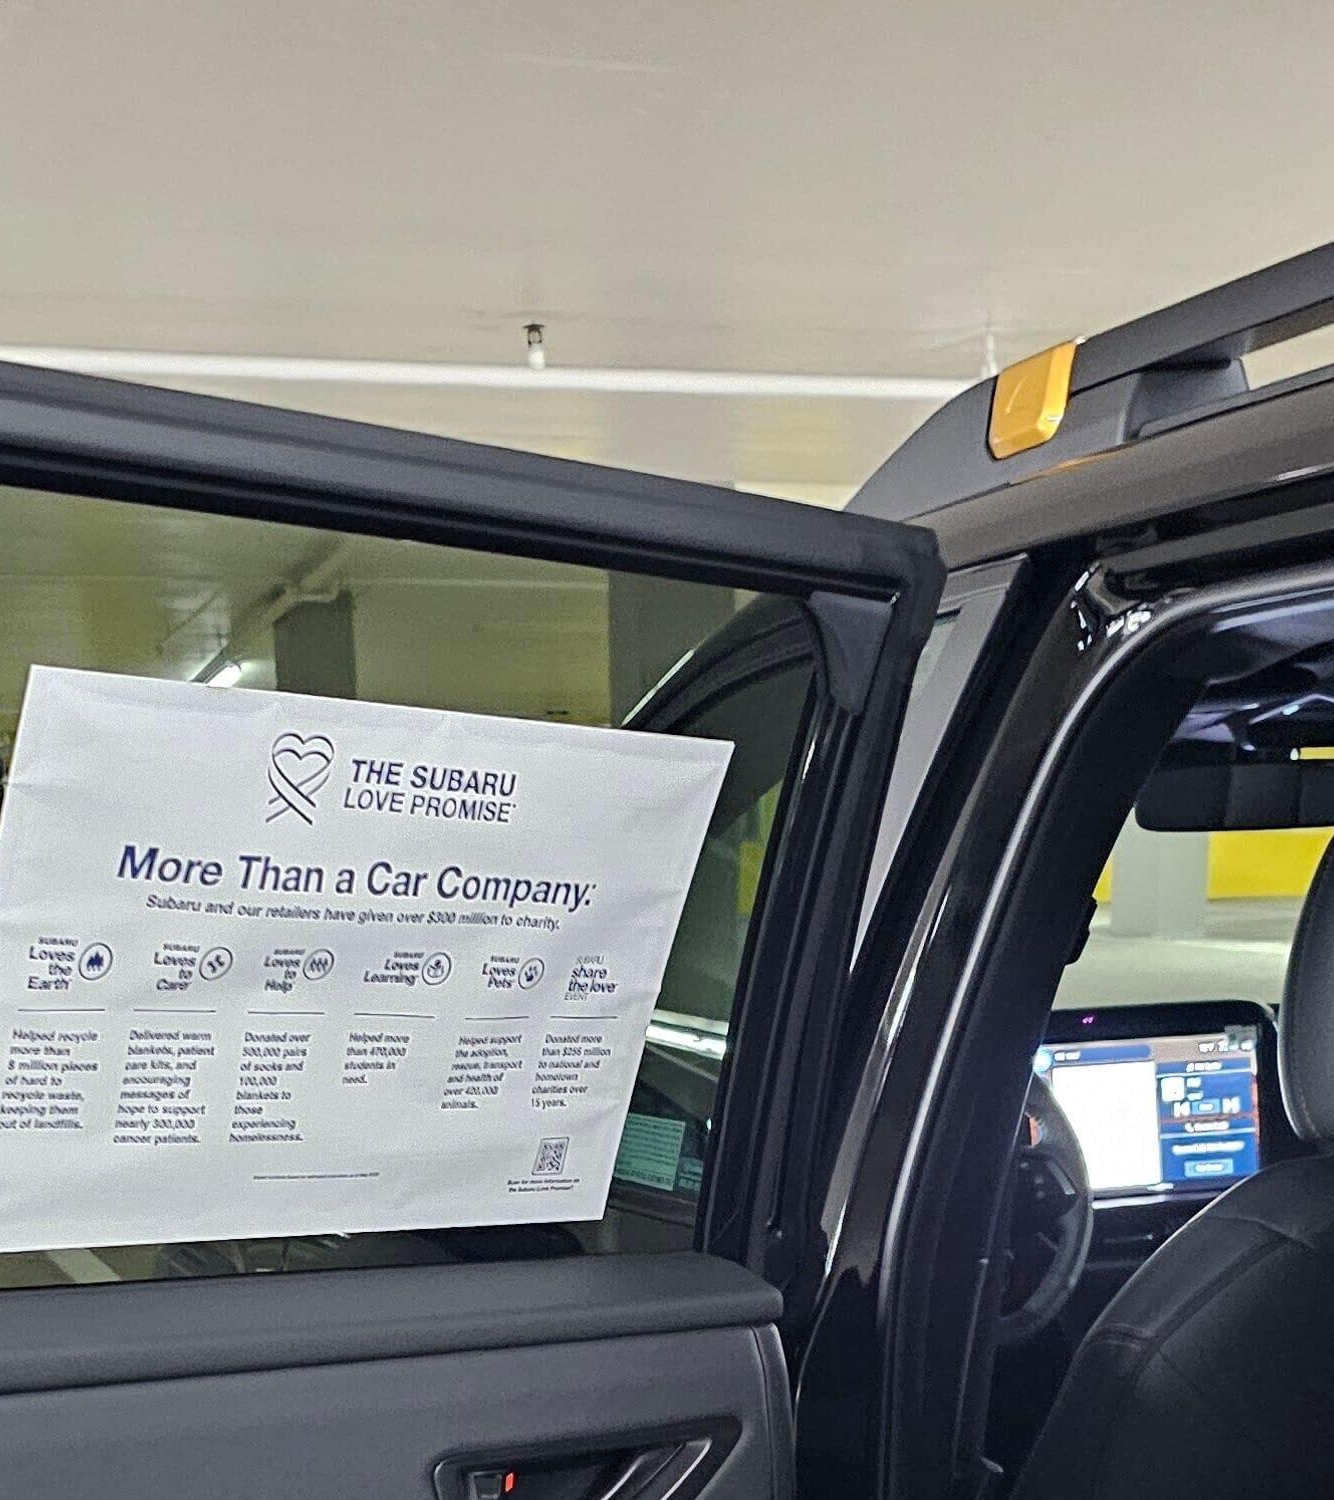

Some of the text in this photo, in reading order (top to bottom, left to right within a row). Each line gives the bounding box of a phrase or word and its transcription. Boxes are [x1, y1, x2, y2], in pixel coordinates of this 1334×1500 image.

[350, 758, 516, 797] THE SUBARU
[344, 787, 511, 824] LOVE PROMISE
[117, 845, 223, 886] More
[239, 854, 323, 893] Than
[335, 869, 355, 894] a
[368, 861, 428, 897] Car
[146, 894, 560, 932] Subaru and our retailers have given over $300 million to charity.
[29, 947, 75, 961] Loves
[154, 952, 196, 967] Loves
[264, 957, 300, 968] Loves
[384, 959, 420, 970] Loves
[49, 963, 72, 976] the
[179, 968, 192, 980] to
[284, 969, 297, 980] to
[482, 963, 516, 977] Loves
[571, 965, 607, 979] share
[27, 976, 70, 990] Earth
[364, 971, 415, 986] Learning
[488, 977, 512, 988] Pets
[265, 980, 293, 994] Help
[568, 980, 588, 992] the
[12, 1029, 98, 1044] Helped recycle
[130, 1030, 211, 1041] Delivered warm
[245, 1033, 311, 1043] Donated over
[349, 1033, 410, 1043] Helped more
[459, 1034, 522, 1047] Helped support
[545, 1034, 602, 1044] Donated more
[44, 1047, 70, 1056] than
[128, 1047, 215, 1057] blankets, patient
[283, 1048, 307, 1058] pairs
[347, 1047, 367, 1057] than
[455, 1049, 468, 1058] the
[542, 1047, 560, 1056] than
[584, 1048, 611, 1056] million
[18, 1061, 58, 1071] million
[61, 1063, 98, 1073] pieces
[125, 1061, 197, 1071] care kits, and
[240, 1062, 304, 1072] of socks and
[345, 1061, 396, 1070] students in
[484, 1060, 522, 1071] transport
[538, 1059, 600, 1069] to national and
[5, 1076, 62, 1086] of hard to
[123, 1077, 190, 1087] encouraging
[342, 1075, 368, 1084] need.
[447, 1072, 503, 1083] and health of
[535, 1072, 578, 1082] hometown
[120, 1090, 191, 1101] messages of
[237, 1091, 291, 1100] blankets to
[444, 1087, 463, 1096] over
[532, 1085, 587, 1095] charities over
[2, 1091, 85, 1101] recycle waste,
[531, 1098, 566, 1110] 15 years.
[0, 1105, 78, 1117] keeping them
[117, 1105, 205, 1115] hope to support
[234, 1105, 263, 1115] those
[19, 1120, 31, 1129] of
[34, 1119, 83, 1130] landfills.
[115, 1120, 149, 1130] nearly
[232, 1119, 296, 1130] experiencing
[113, 1134, 201, 1145] cancer patients.
[229, 1133, 303, 1143] homelessness.
